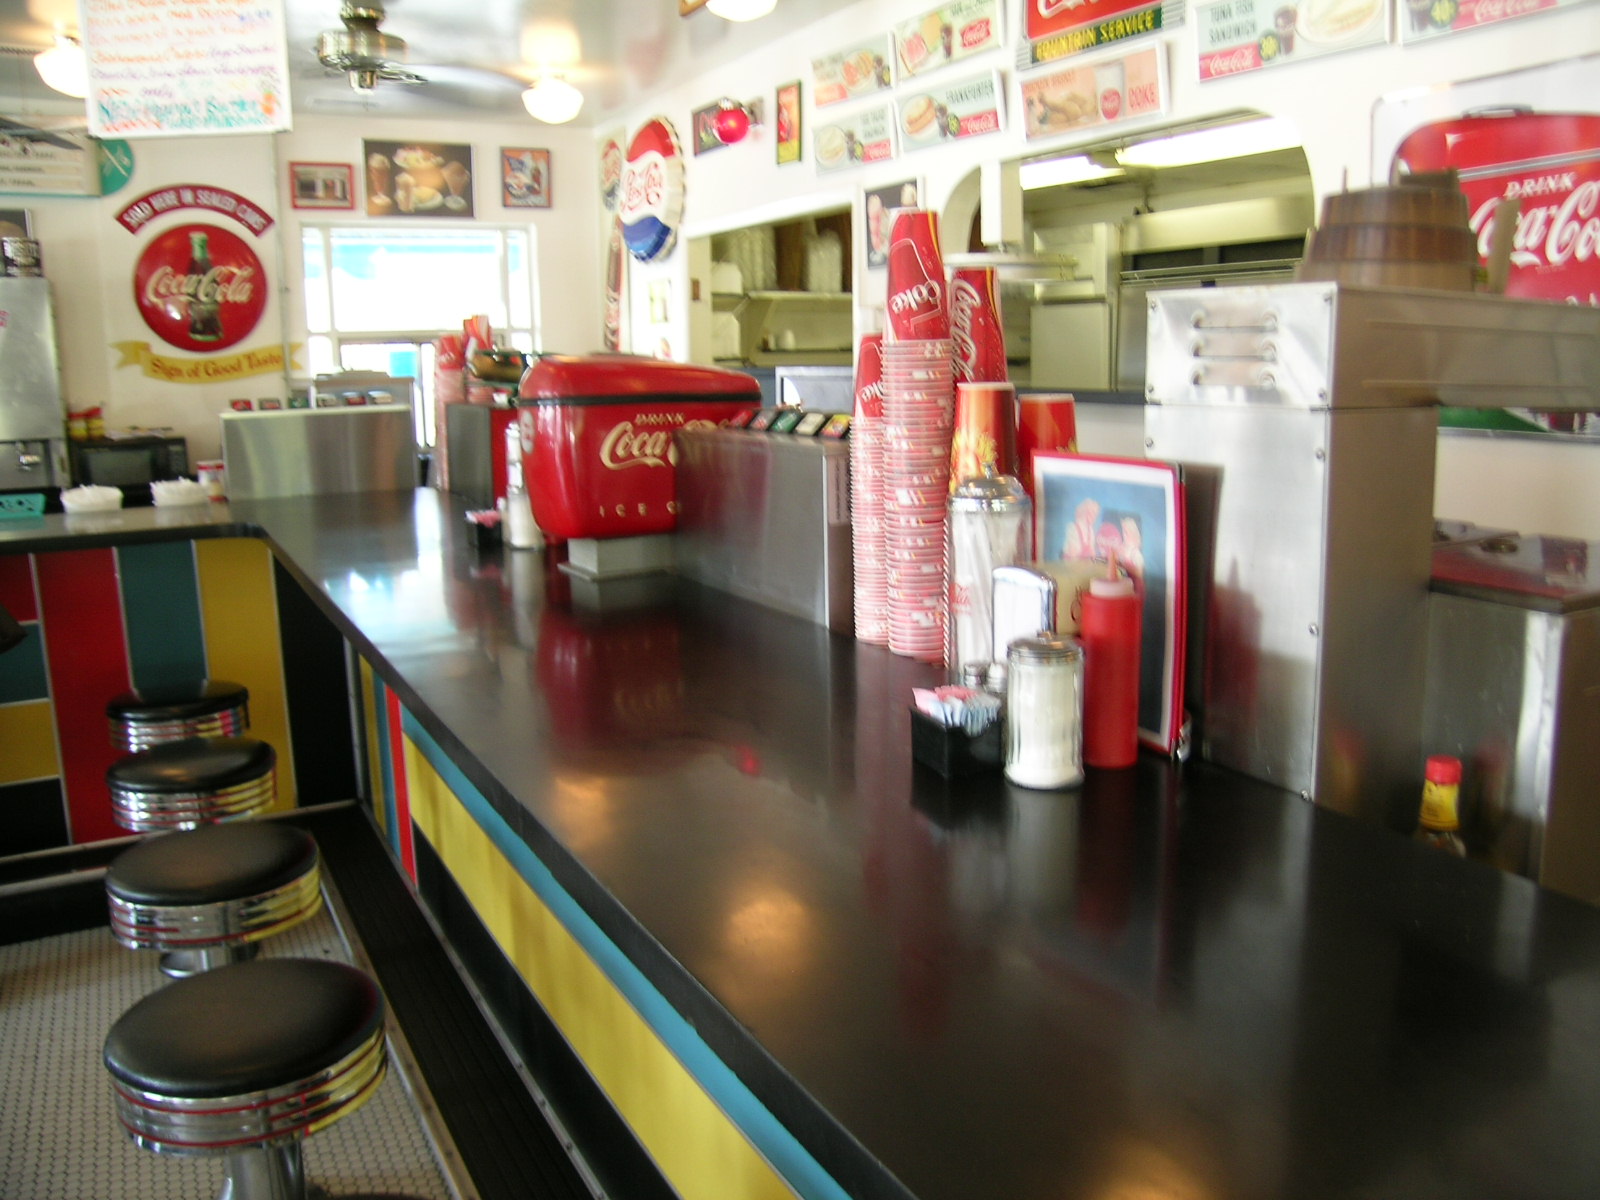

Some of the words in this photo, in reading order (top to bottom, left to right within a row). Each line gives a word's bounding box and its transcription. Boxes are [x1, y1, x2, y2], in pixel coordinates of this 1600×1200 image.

[1036, 27, 1097, 61] FOUNTAIN
[1099, 9, 1155, 42] SERVICE
[1503, 171, 1576, 200] DRINK
[122, 200, 154, 229] SOLD
[144, 265, 254, 306] Coca-Cola
[888, 279, 942, 315] Coke
[152, 358, 184, 380] Sign
[186, 361, 202, 378] of
[203, 359, 244, 377] Good
[243, 352, 284, 370] Taste
[635, 412, 685, 426] DRINK
